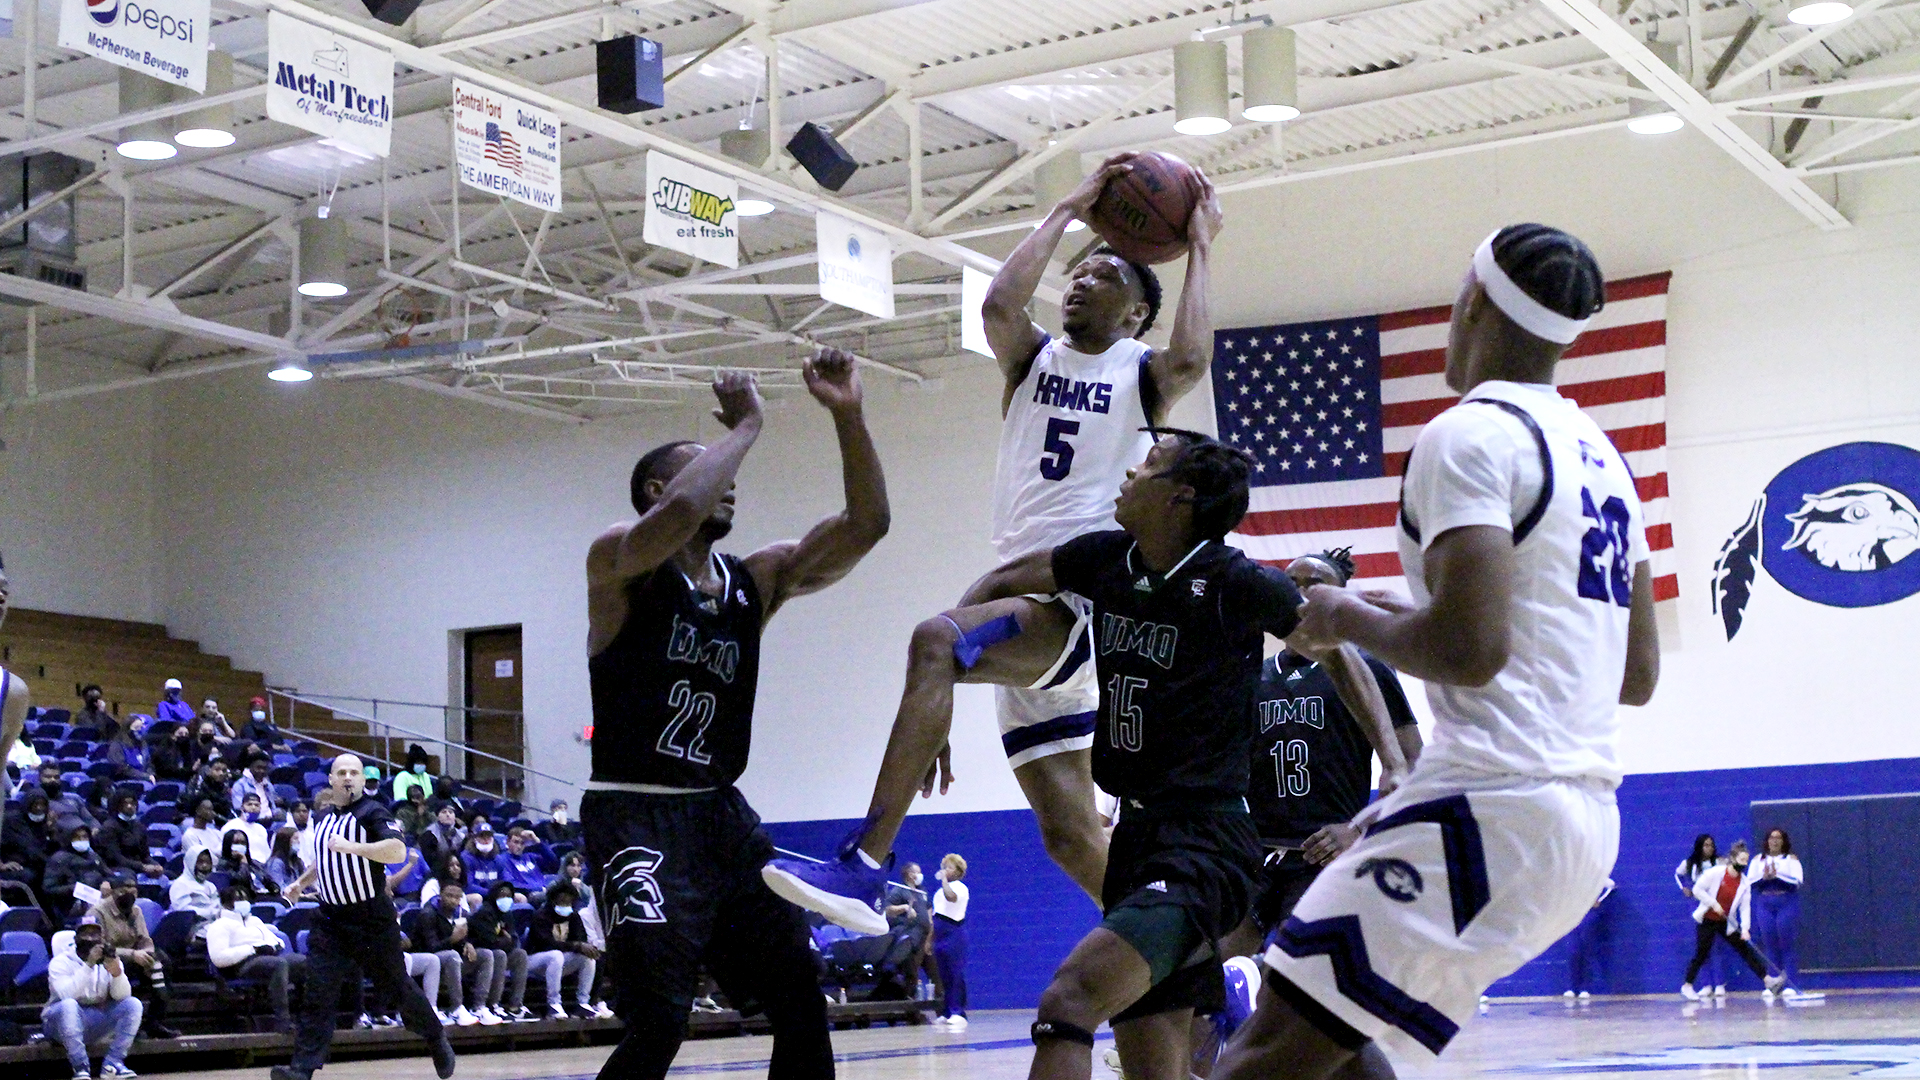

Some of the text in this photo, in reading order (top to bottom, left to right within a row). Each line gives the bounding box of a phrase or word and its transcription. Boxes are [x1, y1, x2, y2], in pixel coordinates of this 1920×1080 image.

[124, 2, 193, 43] pepsi
[87, 31, 189, 79] McPherson Beverage
[275, 61, 389, 122] Metal Tech
[296, 97, 383, 128] Of Murfreesboro
[455, 87, 502, 120] Central Ford
[517, 109, 557, 139] Quick Lane
[547, 141, 556, 150] of
[527, 145, 557, 163] Ahoskie
[457, 162, 475, 182] THE
[476, 171, 530, 200] AMERICAN
[533, 188, 555, 207] WAY
[652, 177, 735, 227] SUBWAY
[676, 226, 697, 238] eat
[1032, 371, 1113, 415] HAWKS
[1040, 417, 1080, 482] 5
[1577, 485, 1632, 608] 20
[1101, 612, 1178, 670] UMO
[656, 679, 716, 765] 22
[1108, 674, 1148, 752] 15
[1259, 695, 1325, 734] UMO
[1270, 739, 1311, 798] 13
